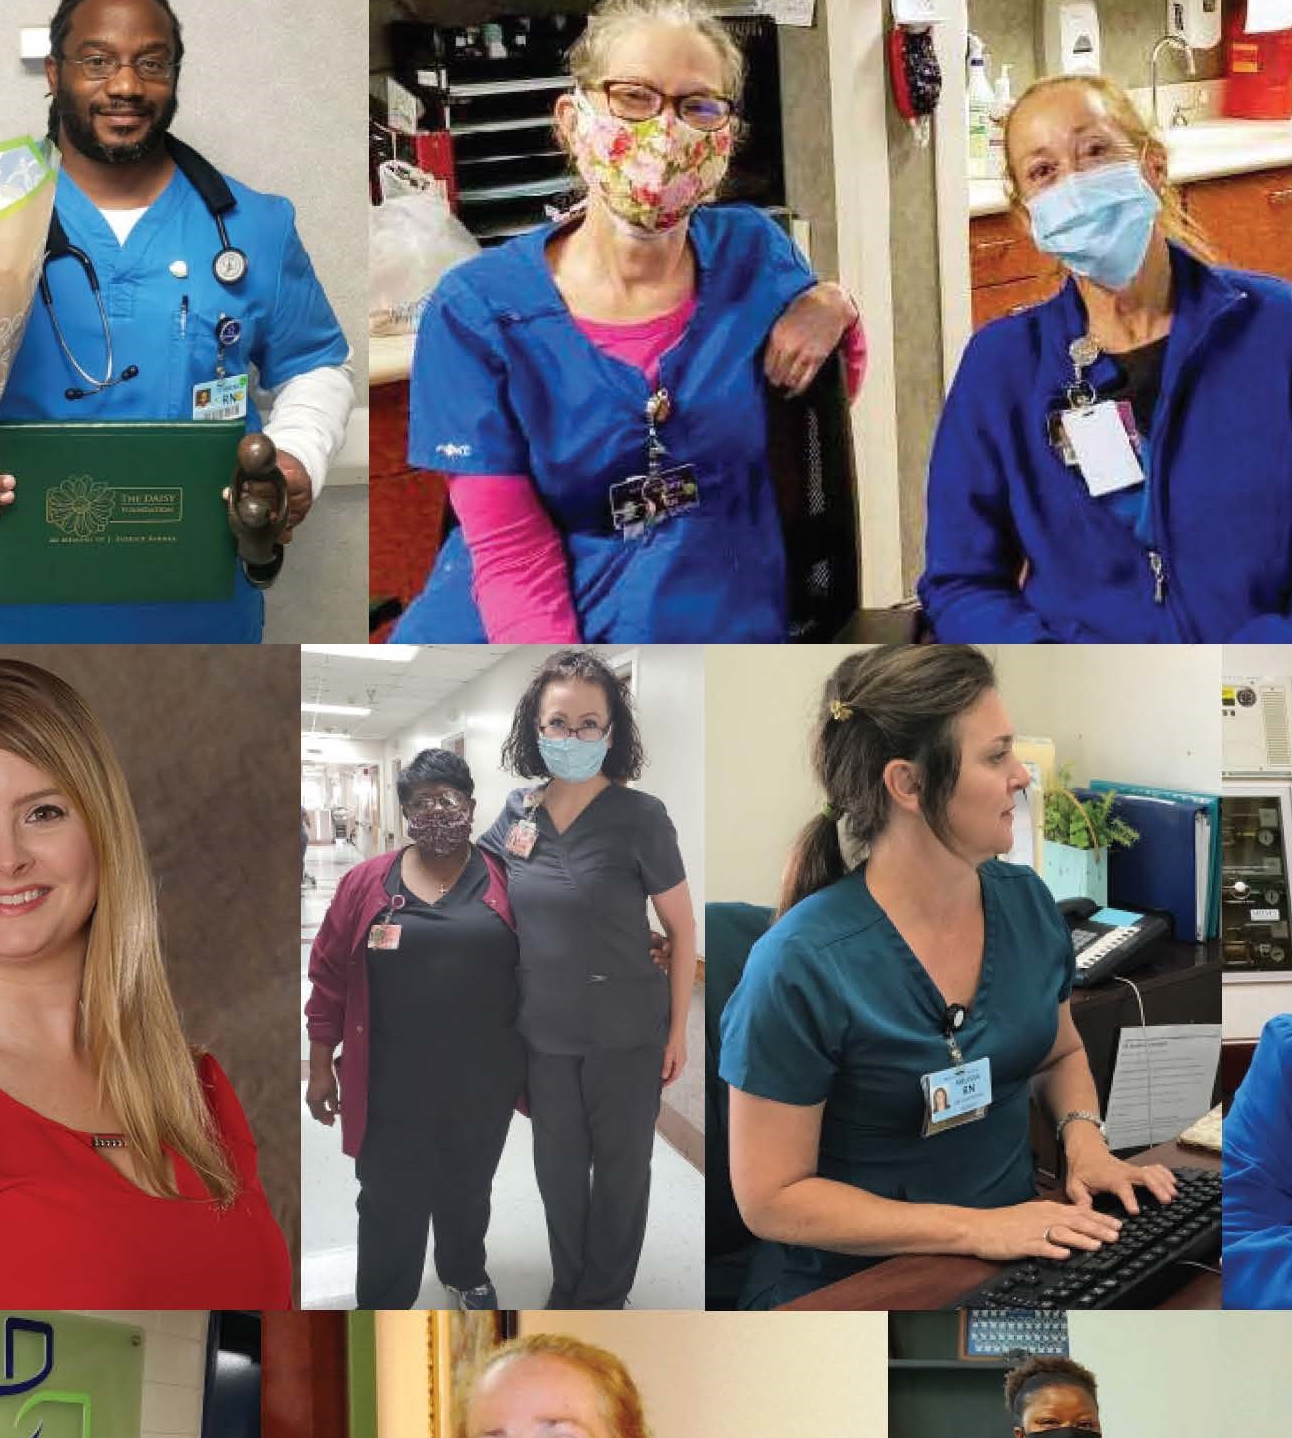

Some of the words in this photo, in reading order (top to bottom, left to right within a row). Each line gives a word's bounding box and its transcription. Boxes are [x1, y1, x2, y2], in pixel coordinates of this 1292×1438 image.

[222, 393, 236, 406] RN
[120, 494, 140, 504] THE
[144, 493, 178, 504] DAISY
[121, 506, 175, 514] FOUNDATION
[962, 1084, 976, 1095] RN
